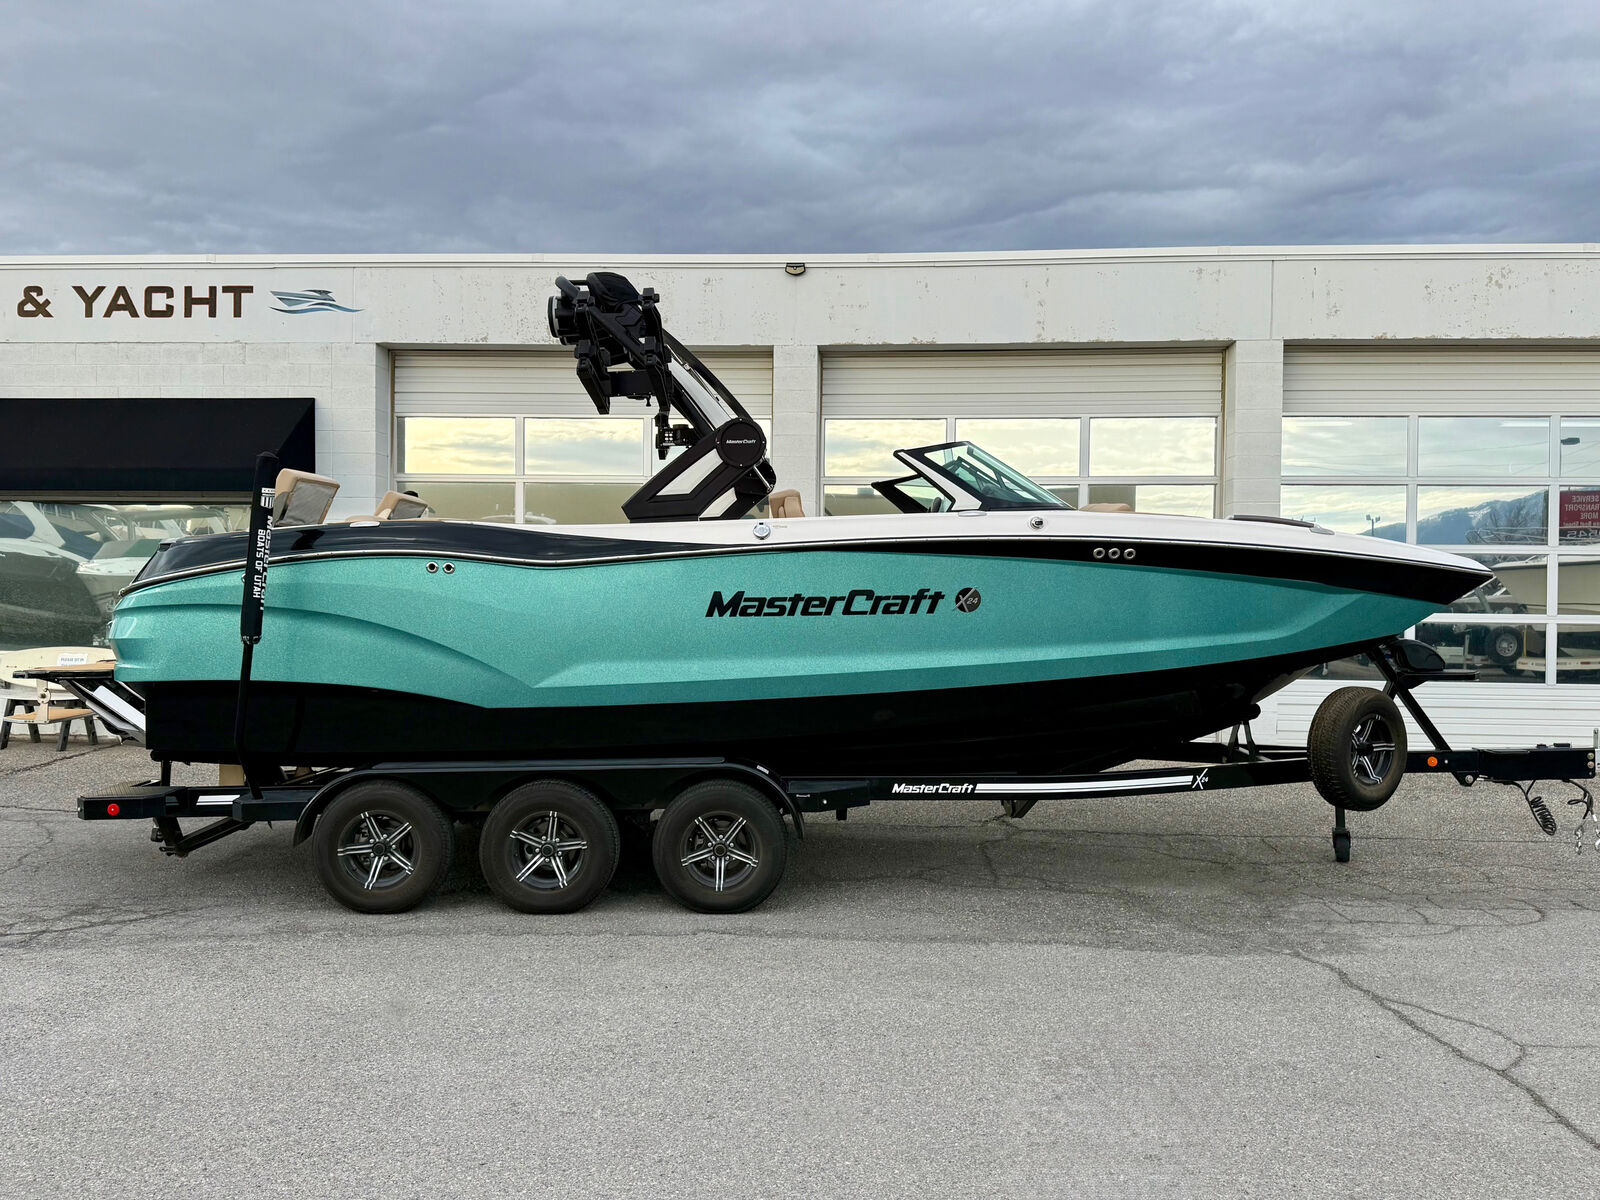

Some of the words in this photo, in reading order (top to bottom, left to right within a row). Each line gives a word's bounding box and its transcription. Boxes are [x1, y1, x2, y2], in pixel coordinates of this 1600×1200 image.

[17, 285, 54, 318] &
[72, 285, 254, 318] YACHT
[256, 529, 265, 558] BOATS
[254, 560, 264, 573] OF
[253, 574, 262, 598] UTAH
[705, 588, 945, 617] MasterCraft
[892, 783, 974, 793] MasterCraft
